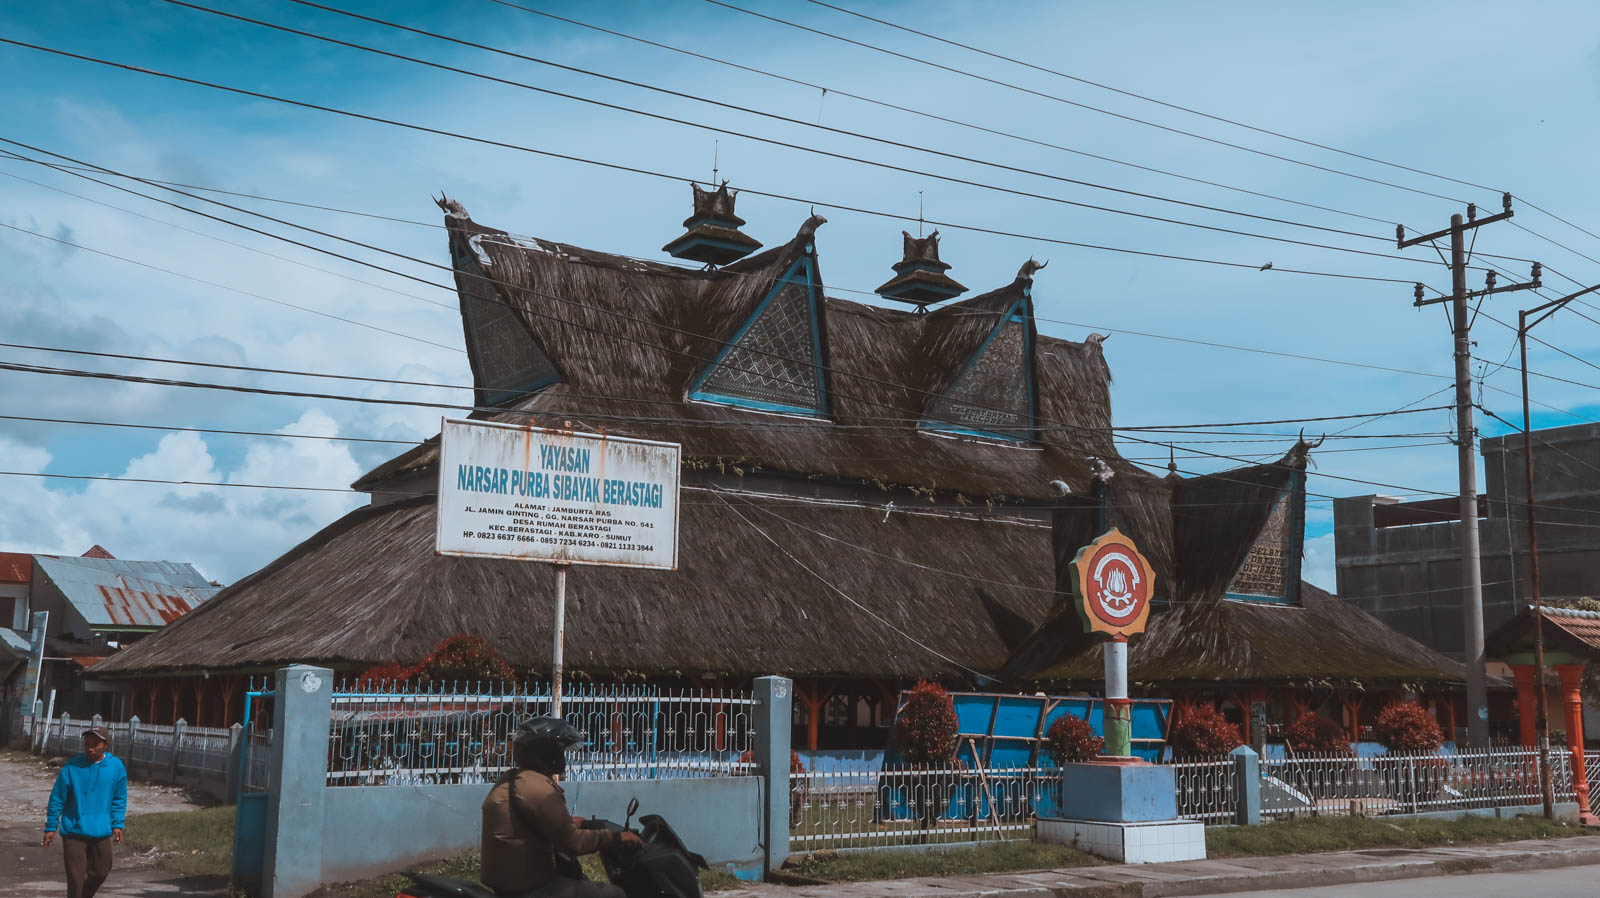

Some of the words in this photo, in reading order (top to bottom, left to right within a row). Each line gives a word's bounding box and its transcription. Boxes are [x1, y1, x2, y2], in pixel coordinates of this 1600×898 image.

[540, 444, 590, 474] YAYASAN
[457, 464, 509, 495] NARSAR
[510, 469, 550, 499] PURBA
[552, 474, 601, 503] SIBAYAK
[603, 479, 663, 509] BERASTAGI
[477, 507, 504, 516] JAMIN
[506, 510, 539, 519] GINTING
[561, 515, 595, 523] NARSAR
[596, 518, 623, 526] PURBA
[624, 520, 638, 528] NO.
[514, 502, 546, 511] ALAMAT
[551, 505, 593, 516] JAMBURTA
[512, 518, 535, 526] DESA
[536, 520, 566, 529] RUMAH
[567, 523, 612, 532] BERASTAGI
[463, 530, 475, 539] HP.
[477, 532, 496, 540] 0823
[516, 535, 535, 543] 6666
[540, 536, 558, 545] 0853
[559, 538, 577, 546] 7234
[600, 542, 617, 550] 0821
[558, 530, 600, 539] KAB.KARO
[605, 534, 632, 542] SUMUT
